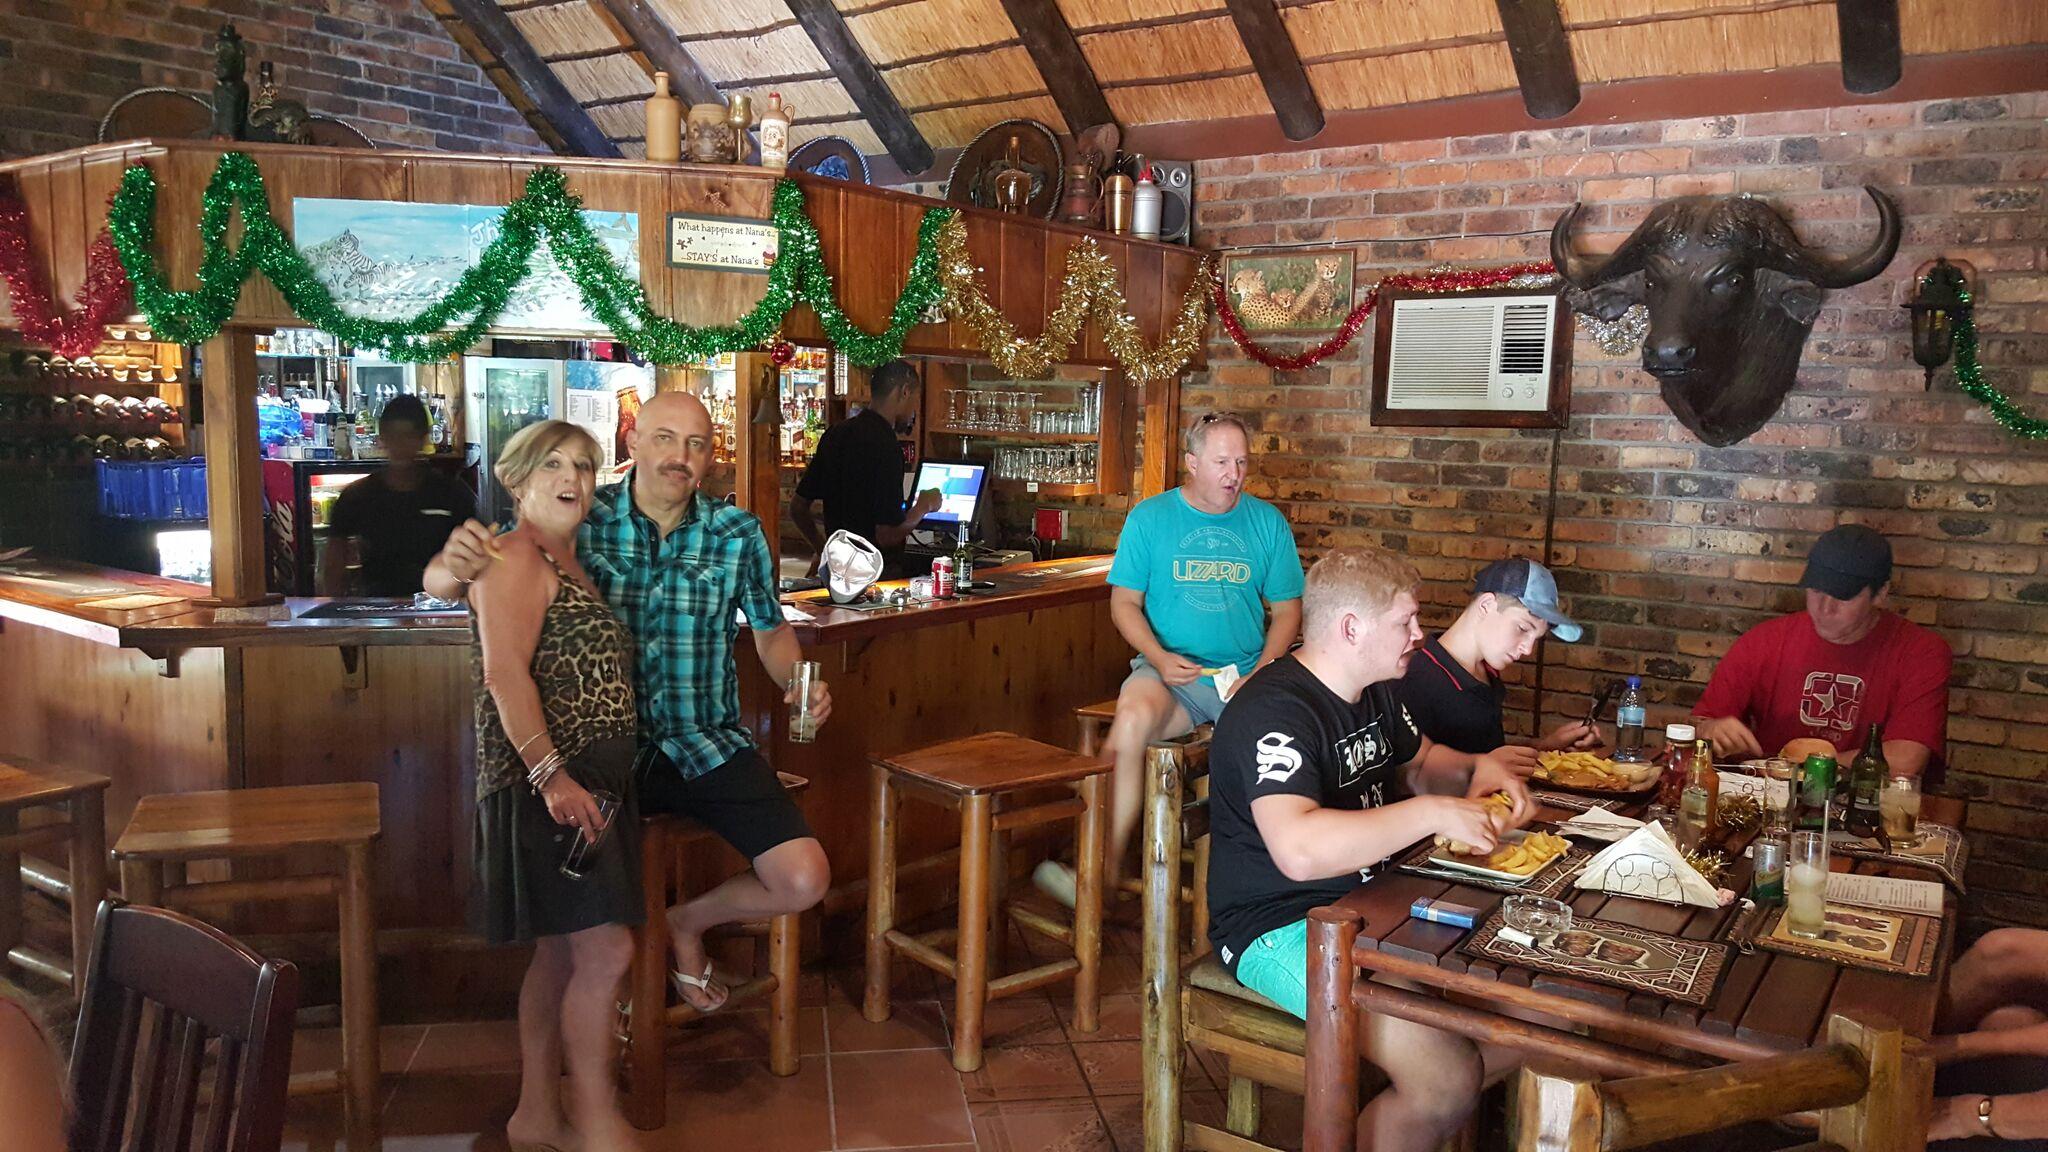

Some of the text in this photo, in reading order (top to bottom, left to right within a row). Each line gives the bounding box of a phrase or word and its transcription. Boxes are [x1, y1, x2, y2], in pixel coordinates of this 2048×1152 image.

[678, 220, 700, 232] What
[701, 223, 734, 236] happens
[735, 227, 744, 235] at
[720, 255, 730, 263] at
[731, 255, 759, 265] Nana's
[1173, 560, 1251, 584] LIZZARD
